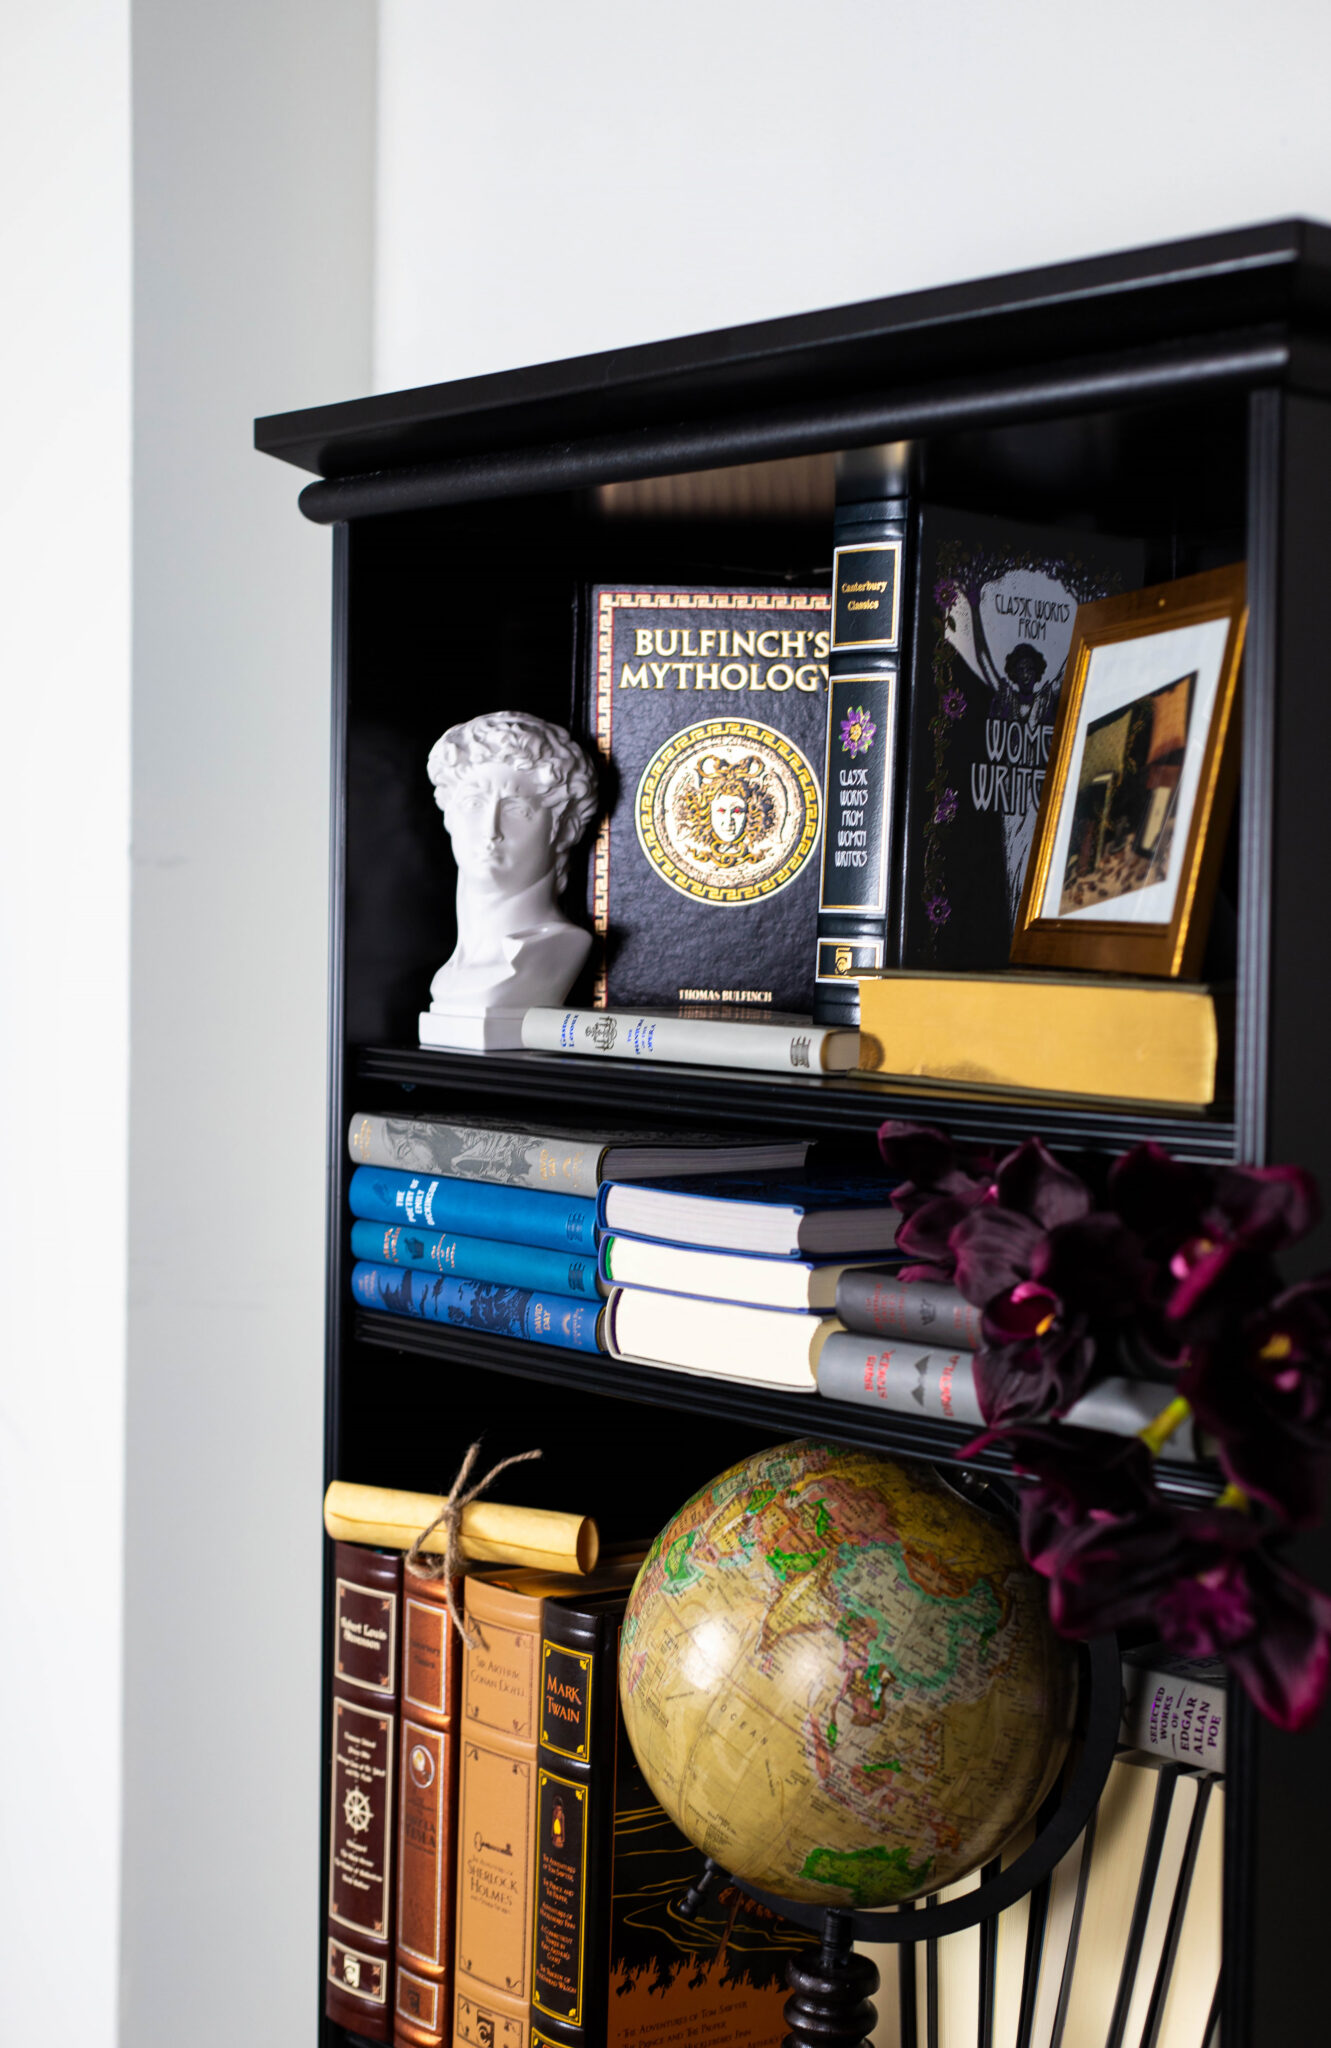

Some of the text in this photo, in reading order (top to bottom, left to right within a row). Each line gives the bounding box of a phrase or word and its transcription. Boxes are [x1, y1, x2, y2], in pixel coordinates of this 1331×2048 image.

[841, 581, 888, 594] Canterbury
[995, 593, 1070, 624] CLASSIC WORKS
[634, 628, 830, 659] BULFINCH'S
[1017, 617, 1047, 641] FROM
[618, 662, 829, 692] MYTHOLOGY
[985, 718, 1055, 765] WOME
[840, 769, 869, 786] CLASSIC
[971, 762, 1047, 814] WRITE
[840, 789, 869, 807] WORKS
[841, 810, 864, 827] FROM
[679, 989, 772, 1002] THOMAS BULFINCH
[546, 1673, 583, 1705] MARK
[546, 1695, 581, 1724] TWAIN
[1149, 1687, 1165, 1744] SELECTED
[1160, 1696, 1173, 1740] WORKS
[1171, 1713, 1179, 1728] OF
[1180, 1697, 1198, 1751] EDGAR
[1194, 1701, 1211, 1755] ALLAN
[1207, 1715, 1221, 1748] POE
